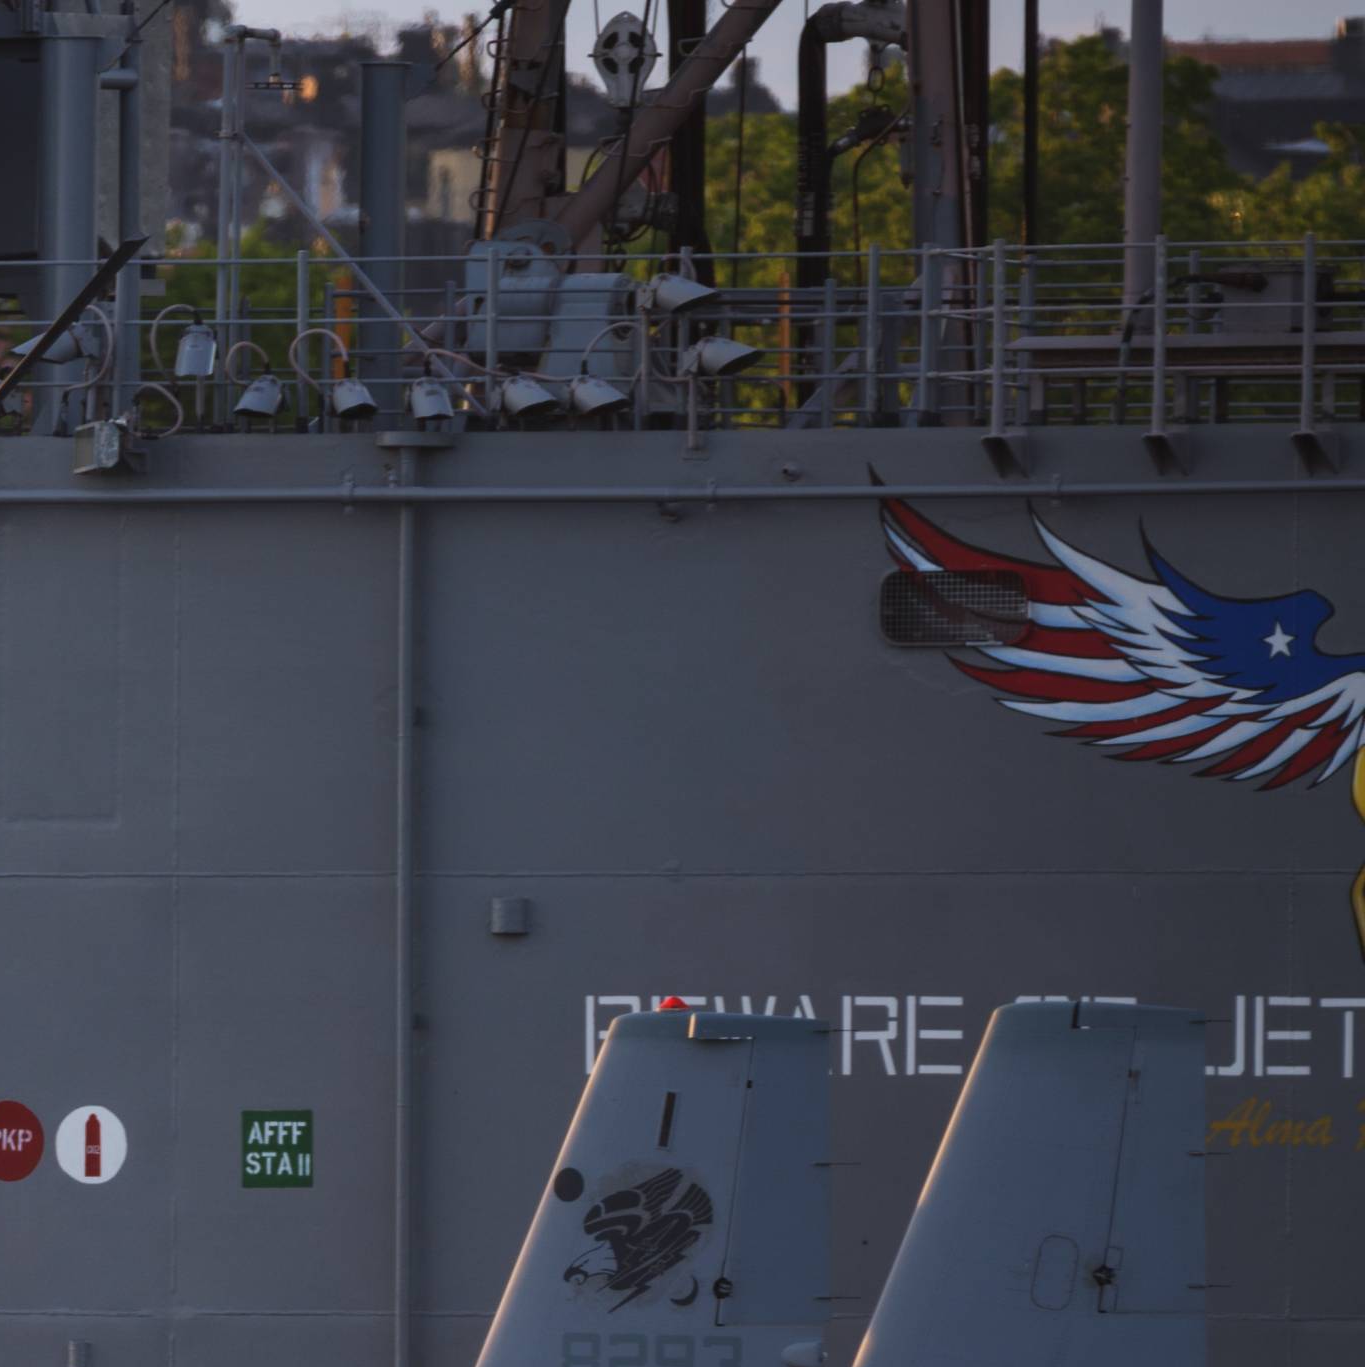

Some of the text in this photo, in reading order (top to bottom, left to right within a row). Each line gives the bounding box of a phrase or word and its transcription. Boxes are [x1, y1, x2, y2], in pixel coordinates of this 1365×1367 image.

[248, 1121, 307, 1145] AFFF
[1205, 1096, 1333, 1148] Alma
[245, 1152, 293, 1176] STA
